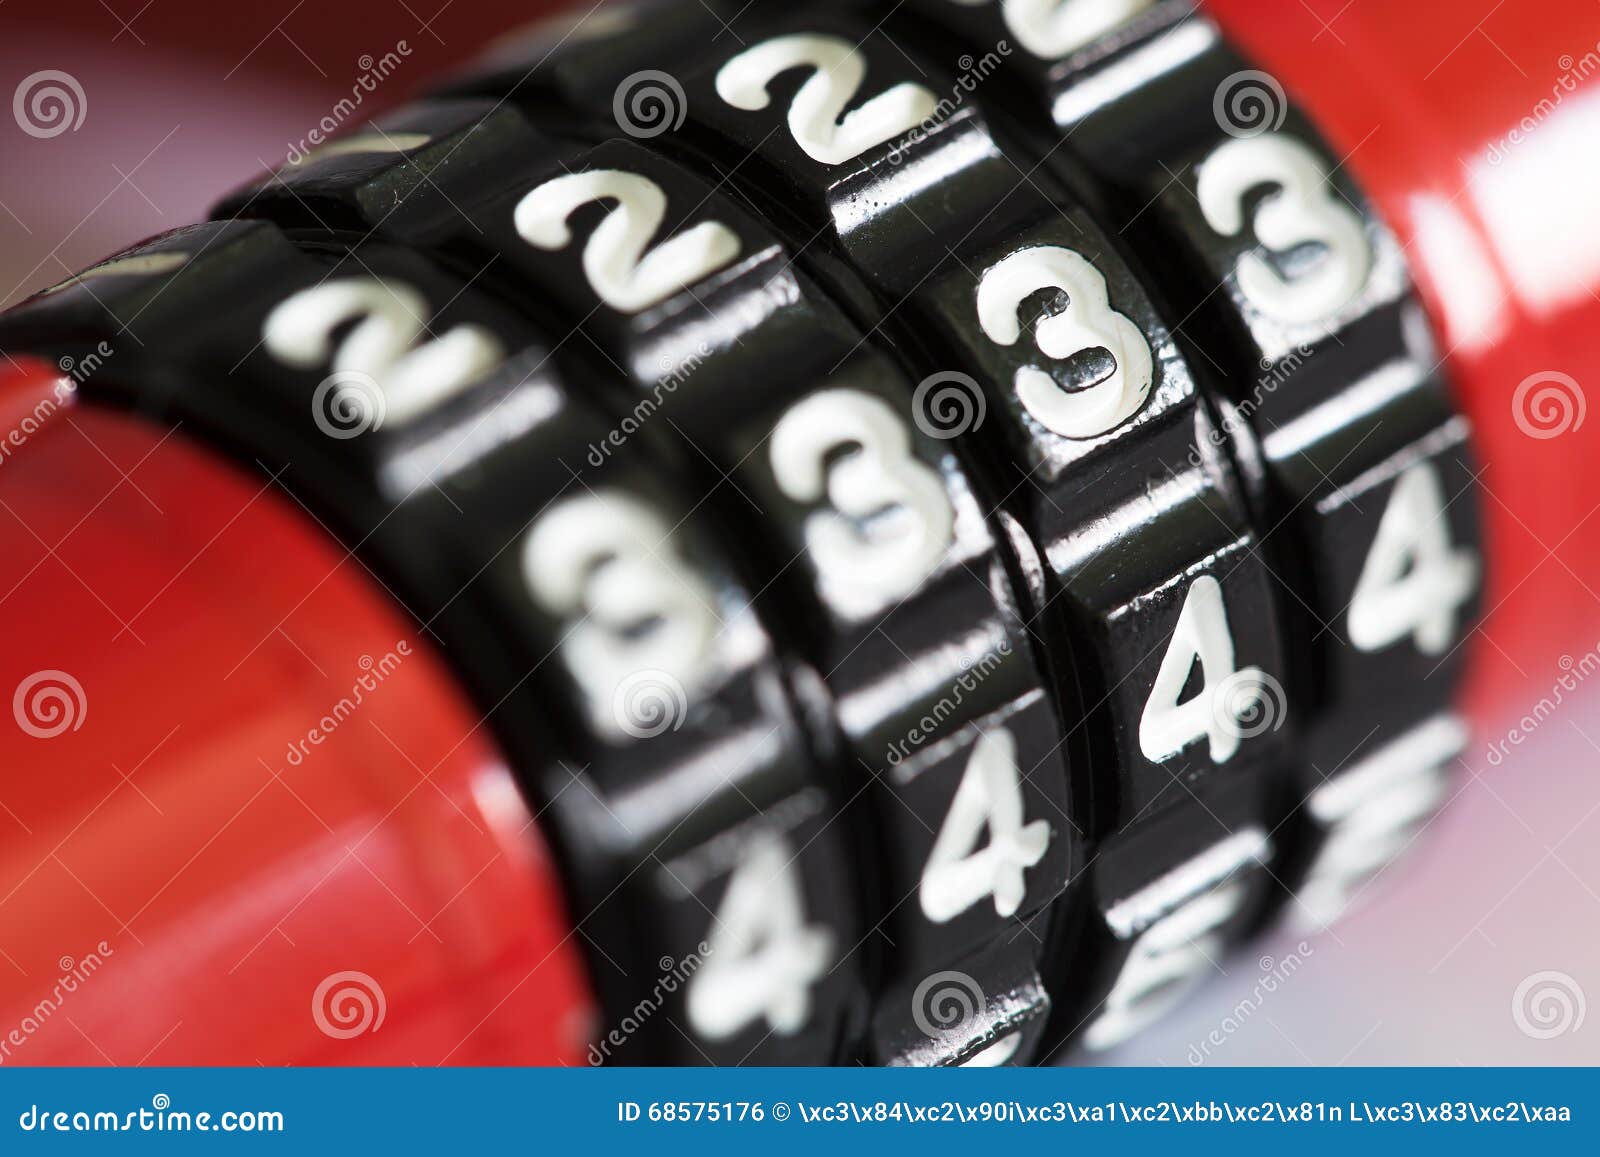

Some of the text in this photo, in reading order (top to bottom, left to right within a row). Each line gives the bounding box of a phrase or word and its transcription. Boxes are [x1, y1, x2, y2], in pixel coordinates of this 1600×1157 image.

[716, 33, 939, 166] 2
[514, 168, 741, 313] 2
[1197, 133, 1372, 326] 3
[263, 277, 500, 431] 2
[977, 245, 1154, 441] 3
[769, 388, 957, 620] 3
[1348, 463, 1481, 656] 4
[522, 487, 716, 743] 3
[1138, 574, 1265, 764] 4
[920, 726, 1051, 923] 4
[685, 828, 834, 1040] 4
